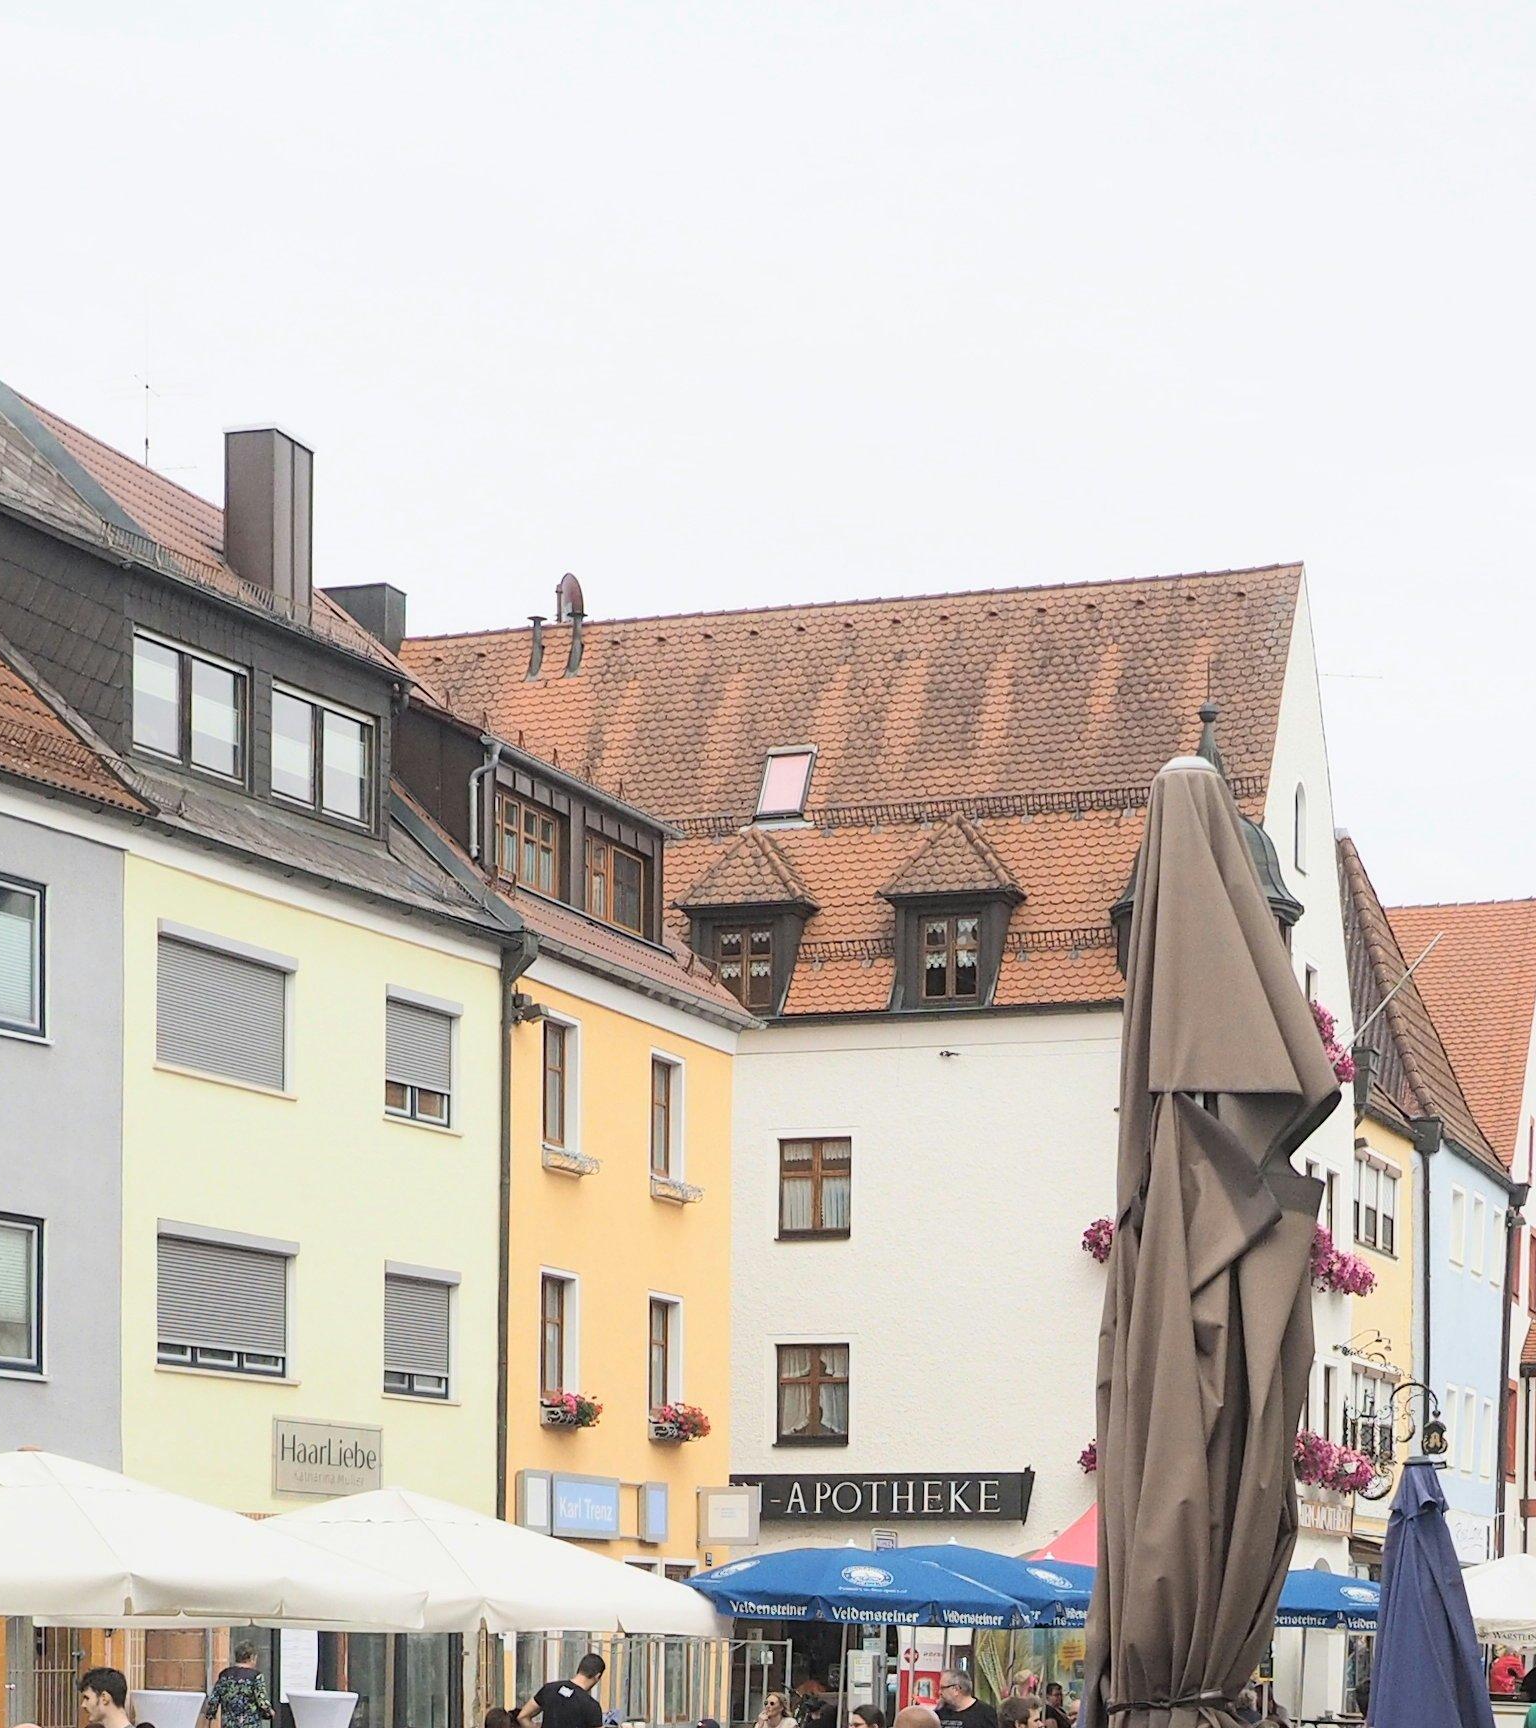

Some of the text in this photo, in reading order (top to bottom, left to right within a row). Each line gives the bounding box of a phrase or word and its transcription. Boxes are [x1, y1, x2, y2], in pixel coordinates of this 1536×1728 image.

[280, 1432, 377, 1471] HaarLiebe
[559, 1496, 614, 1523] Karl Trenz
[729, 1600, 808, 1618] Veldensteiner
[831, 1605, 920, 1626] Veldensteiner
